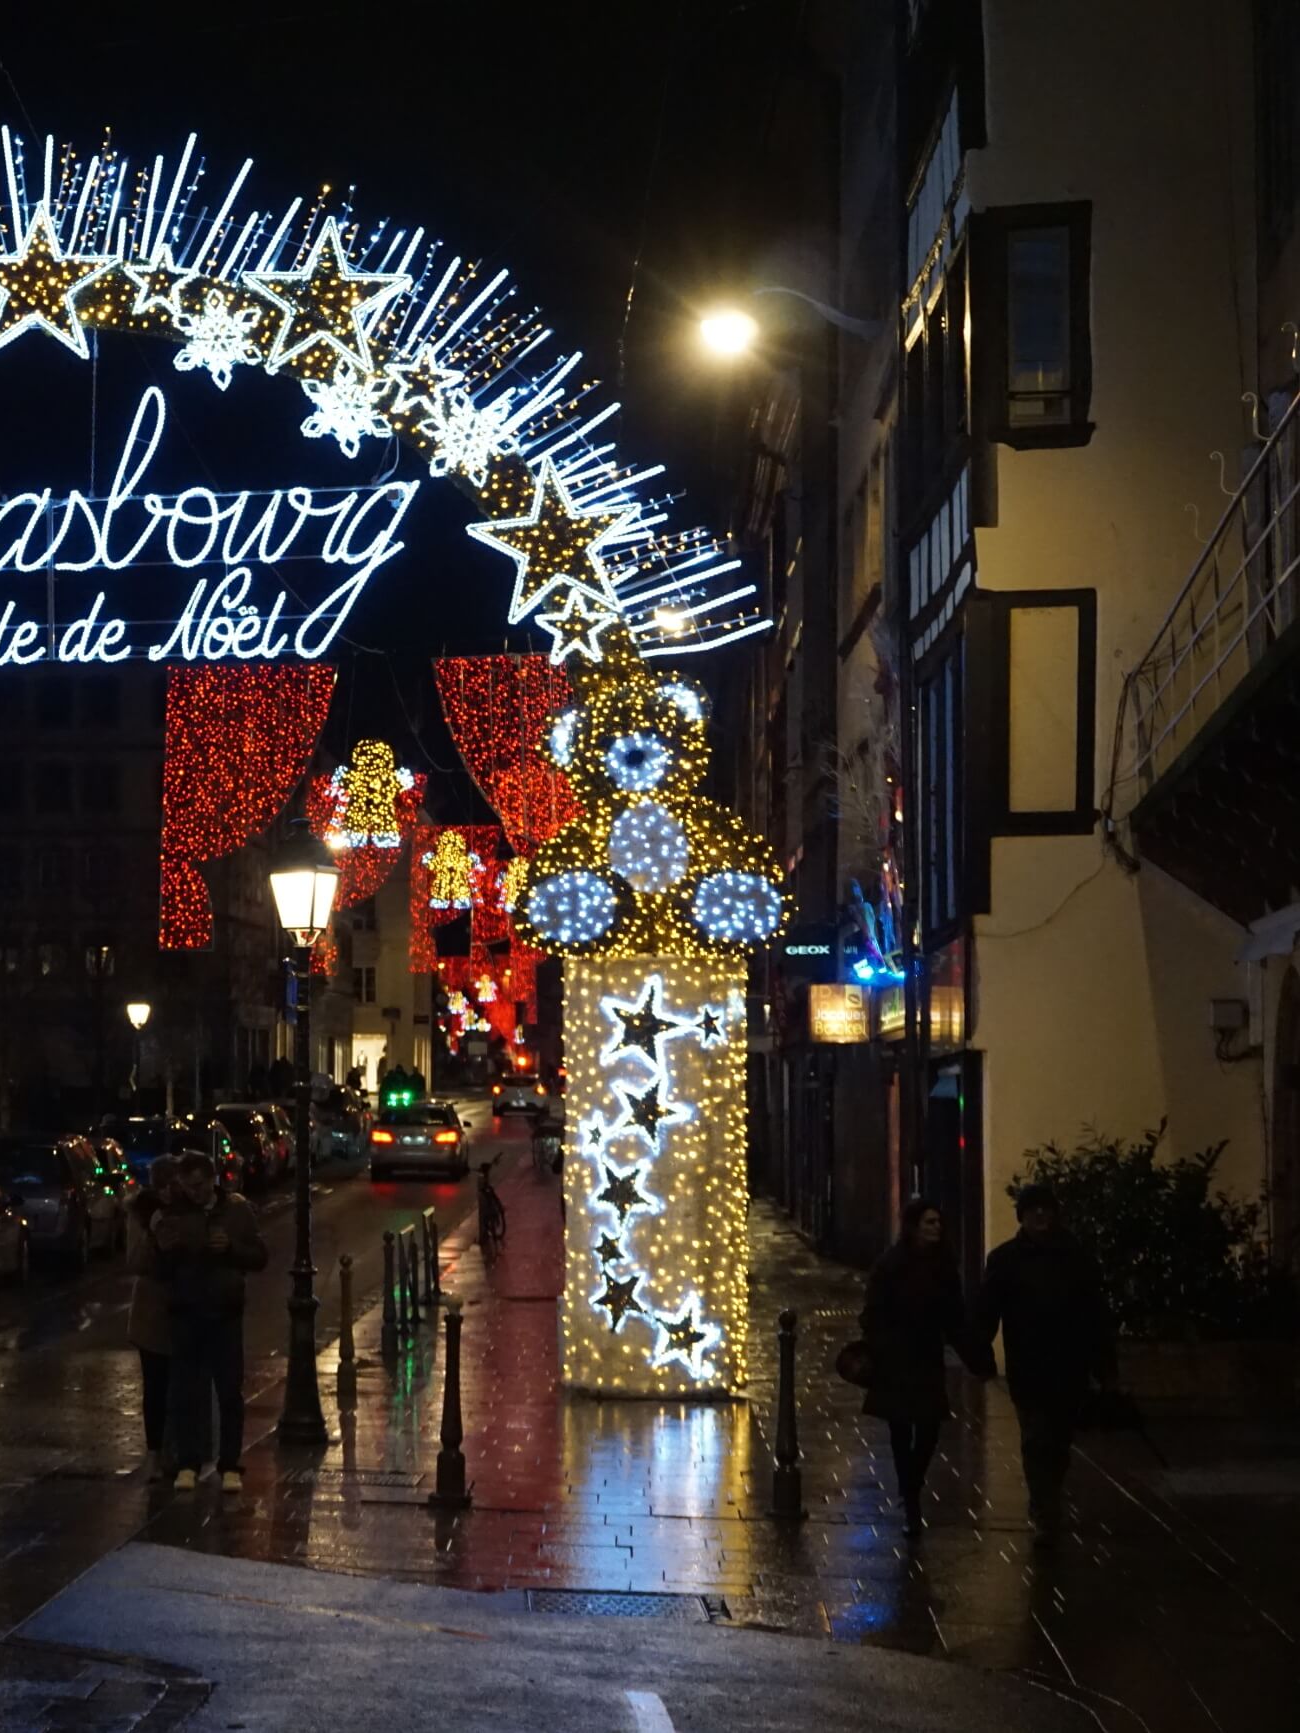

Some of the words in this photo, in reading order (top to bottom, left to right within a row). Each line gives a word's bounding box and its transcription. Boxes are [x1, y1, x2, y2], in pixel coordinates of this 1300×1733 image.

[57, 592, 132, 664] de
[148, 567, 288, 662] Noël
[785, 944, 831, 956] GEOX
